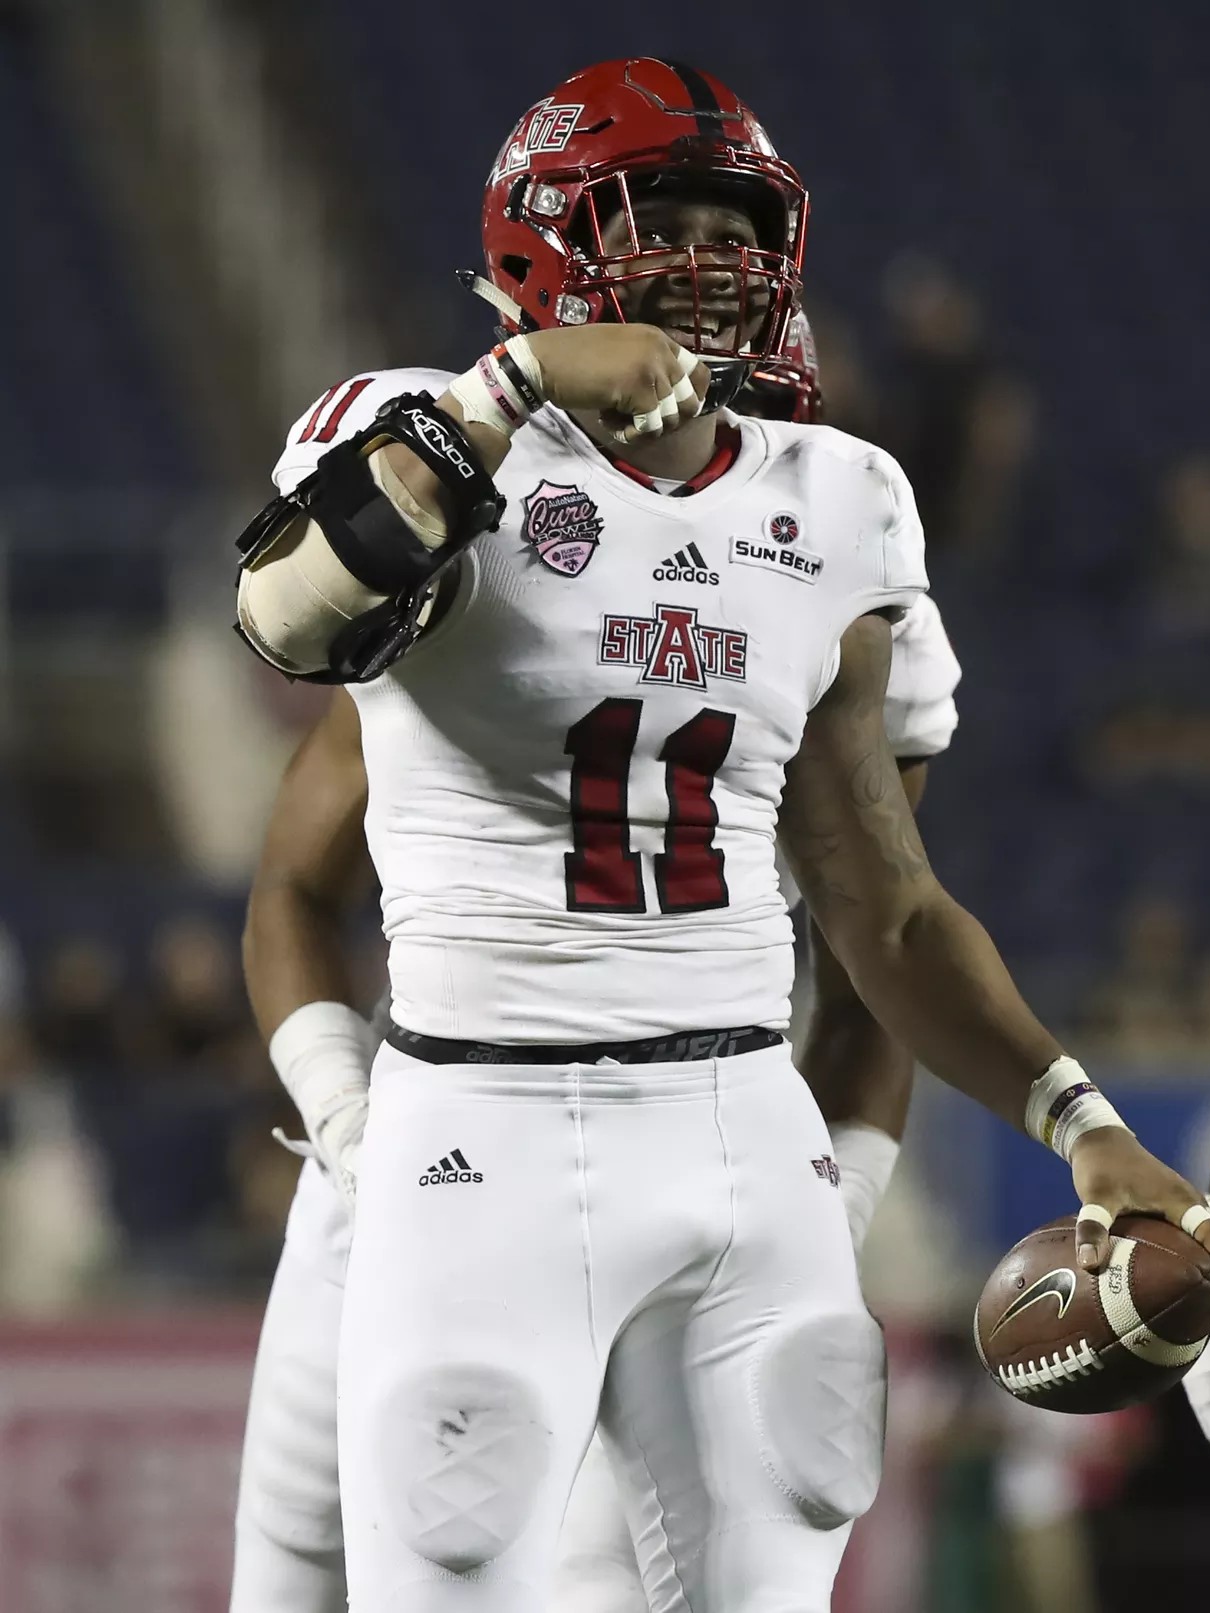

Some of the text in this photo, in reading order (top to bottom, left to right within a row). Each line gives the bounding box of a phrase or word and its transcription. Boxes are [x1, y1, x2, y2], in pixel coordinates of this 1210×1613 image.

[493, 97, 585, 182] ATE
[296, 378, 376, 444] 11
[402, 408, 476, 479] DONJOY
[528, 500, 596, 541] Cure
[548, 494, 588, 508] AutoNation
[537, 522, 597, 544] BOWL
[652, 565, 720, 586] adidas
[735, 541, 821, 576] SUN BELT
[599, 603, 747, 692] STATE
[564, 697, 737, 914] 11
[419, 1170, 484, 1186] adidas
